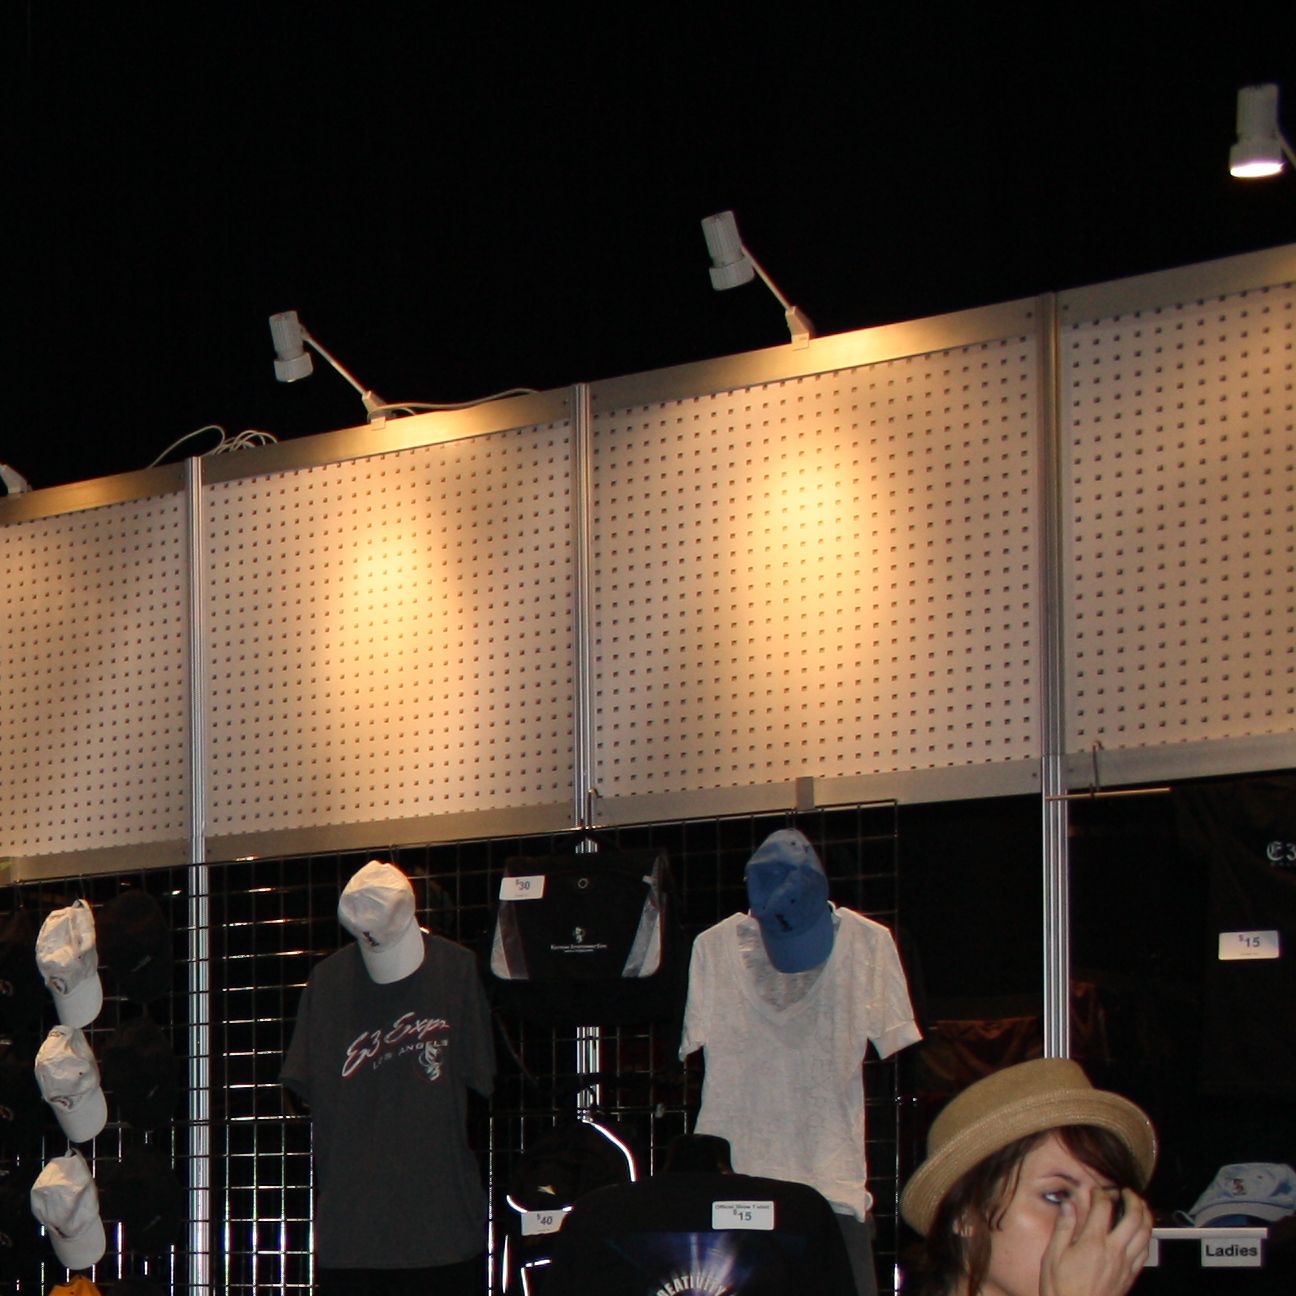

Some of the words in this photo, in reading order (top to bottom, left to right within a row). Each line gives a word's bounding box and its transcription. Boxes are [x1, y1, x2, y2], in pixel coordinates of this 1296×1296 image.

[1238, 934, 1260, 947] $15
[536, 1213, 554, 1226] $40
[732, 1209, 753, 1222] $15
[1205, 1244, 1258, 1258] Ladies
